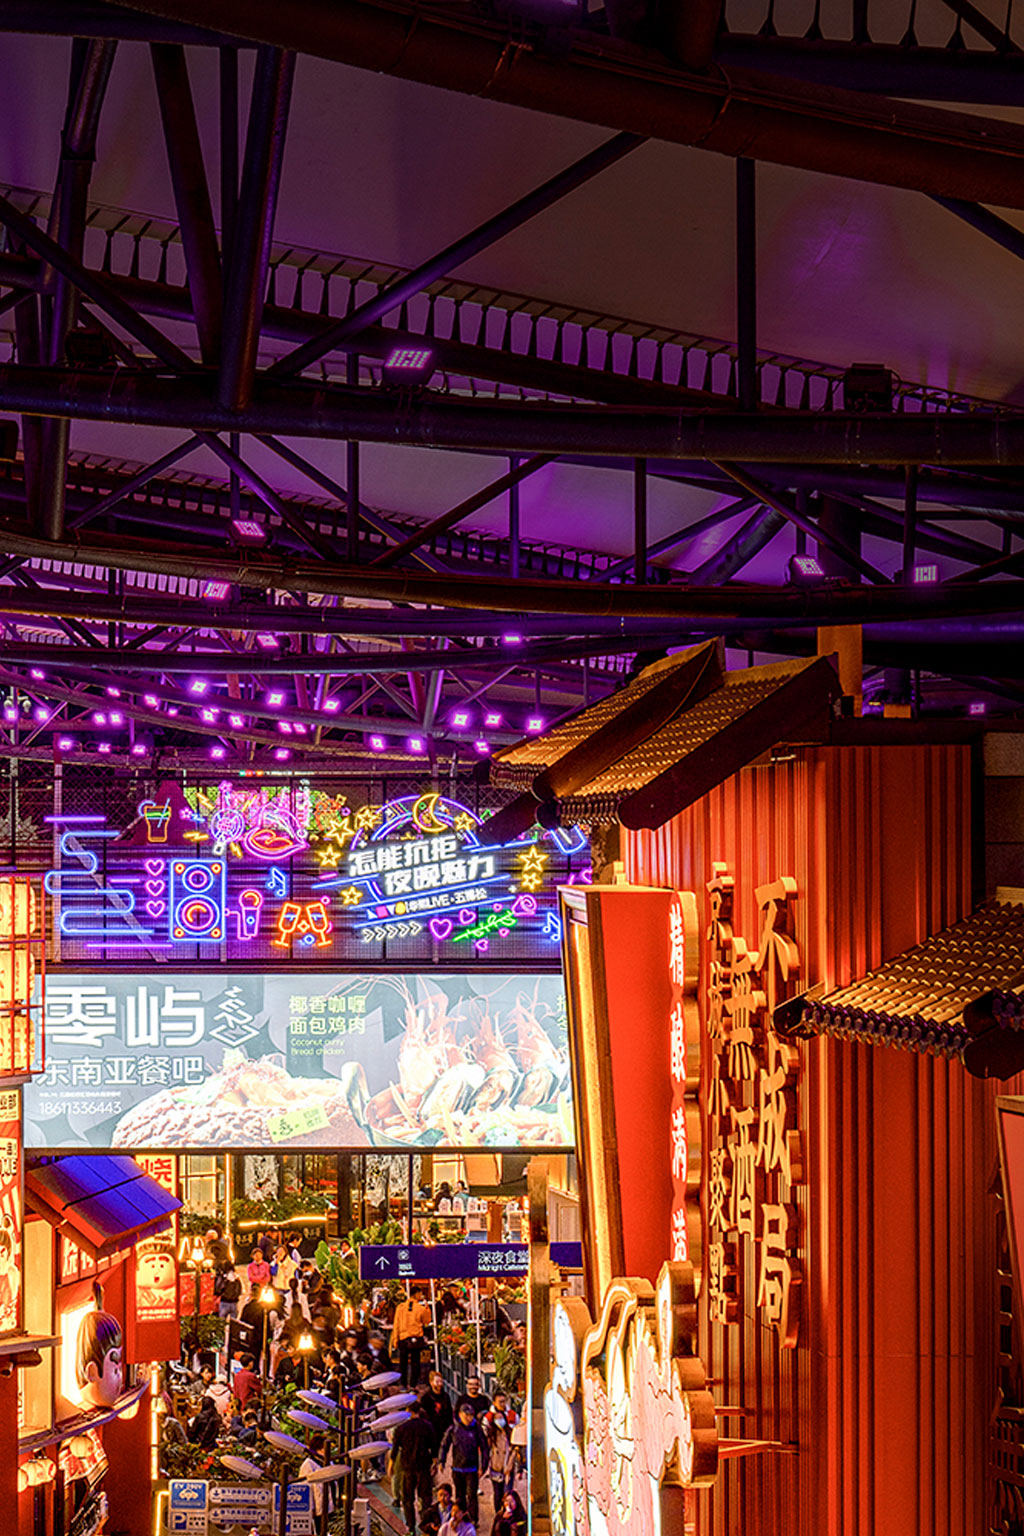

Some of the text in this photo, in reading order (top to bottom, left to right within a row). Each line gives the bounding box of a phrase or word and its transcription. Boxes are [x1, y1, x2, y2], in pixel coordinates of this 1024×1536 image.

[348, 834, 458, 877] 怎能抗拒
[38, 984, 206, 1048] 零屿
[288, 995, 367, 1014] 椰香咖喱
[288, 1017, 367, 1036] 面包鸡肉
[35, 1054, 205, 1087] 东南亚餐吧
